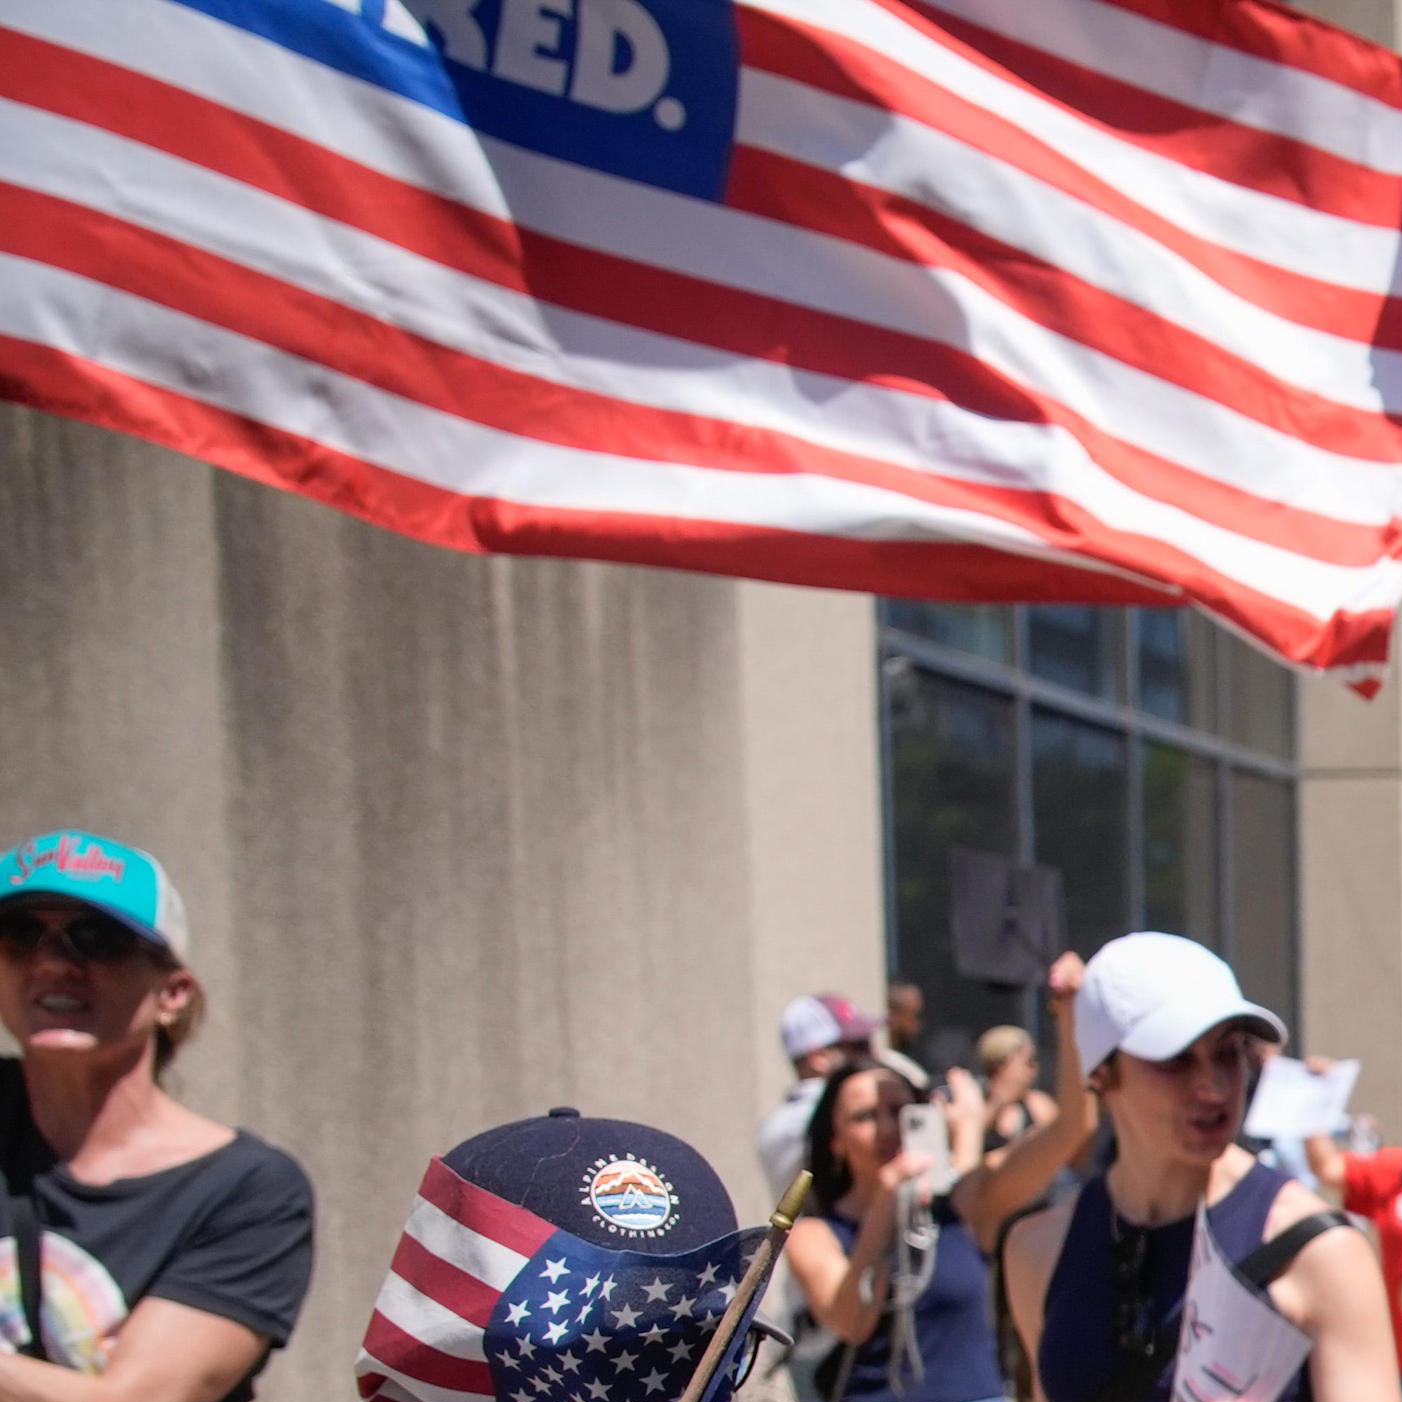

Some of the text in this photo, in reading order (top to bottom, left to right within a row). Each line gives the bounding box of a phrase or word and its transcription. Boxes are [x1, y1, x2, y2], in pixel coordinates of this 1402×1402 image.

[579, 1152, 680, 1205] ALPINE DESIGN
[592, 1215, 665, 1238] CLOTHING
